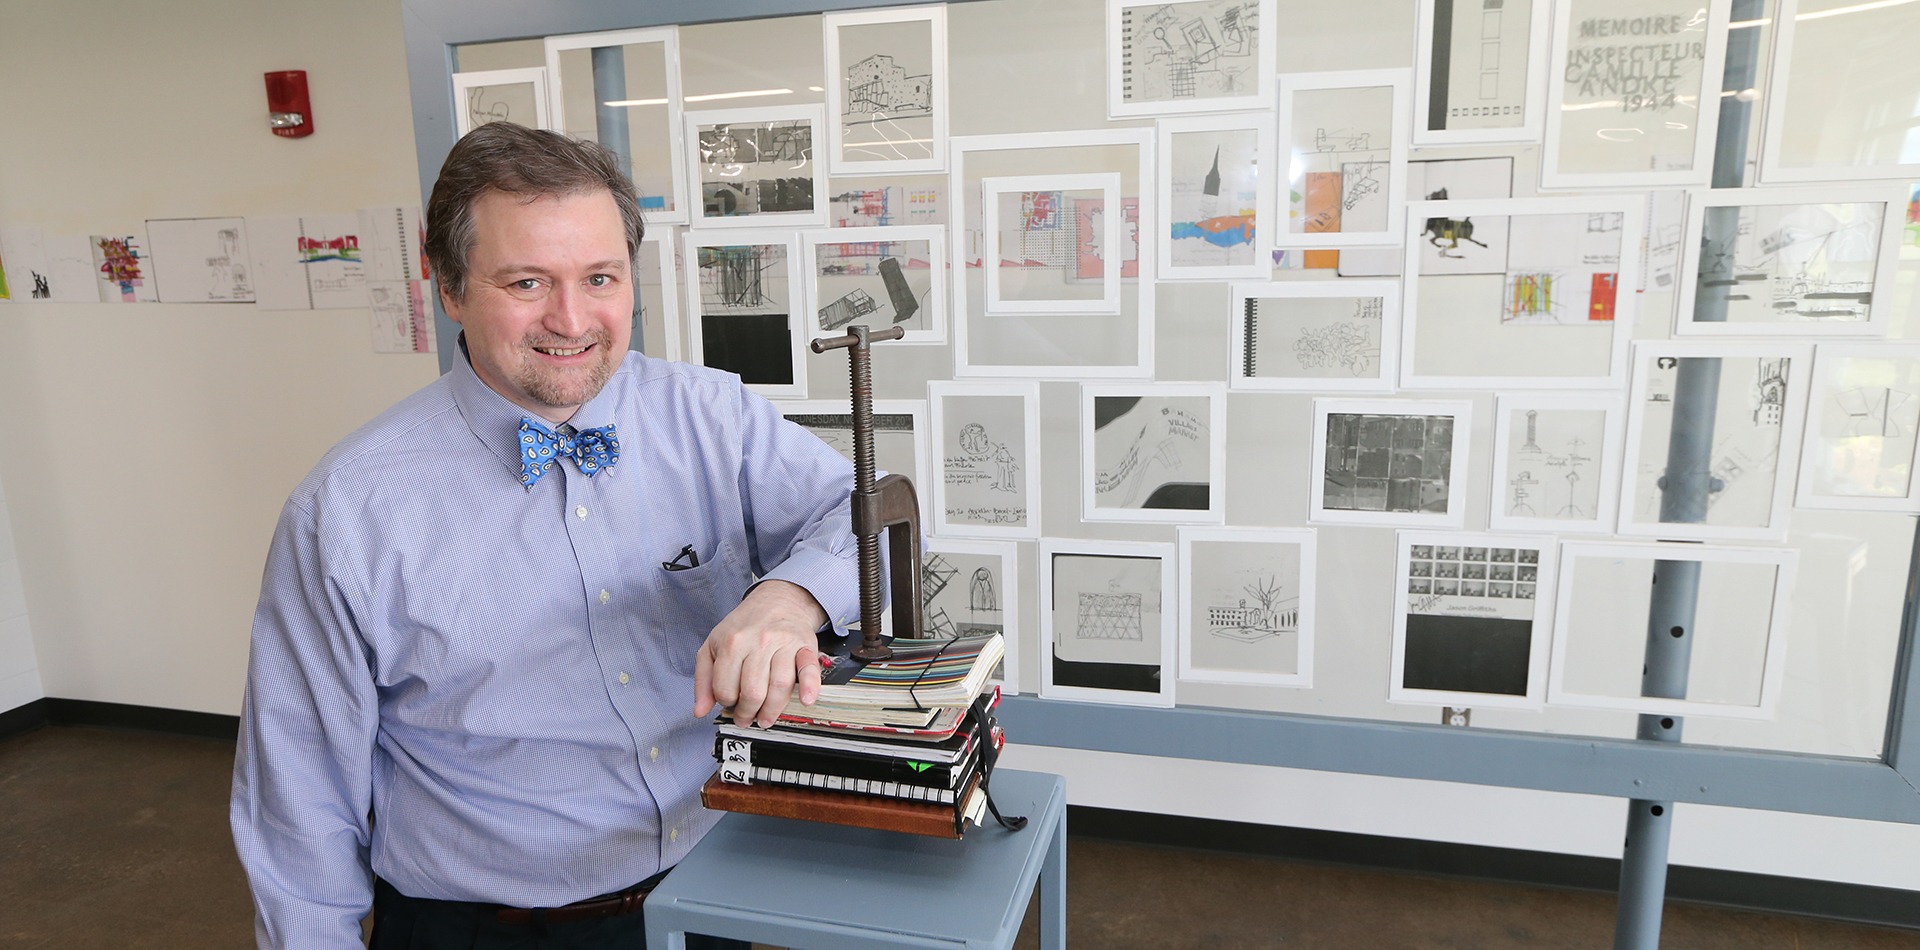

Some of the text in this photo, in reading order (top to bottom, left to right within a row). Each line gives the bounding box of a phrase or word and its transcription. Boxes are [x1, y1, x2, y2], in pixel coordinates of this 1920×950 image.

[1580, 16, 1681, 38] MEMOIRE
[1567, 42, 1704, 65] INSPECTEUR
[1564, 58, 1682, 83] CAMILLE
[1621, 94, 1676, 112] 1944
